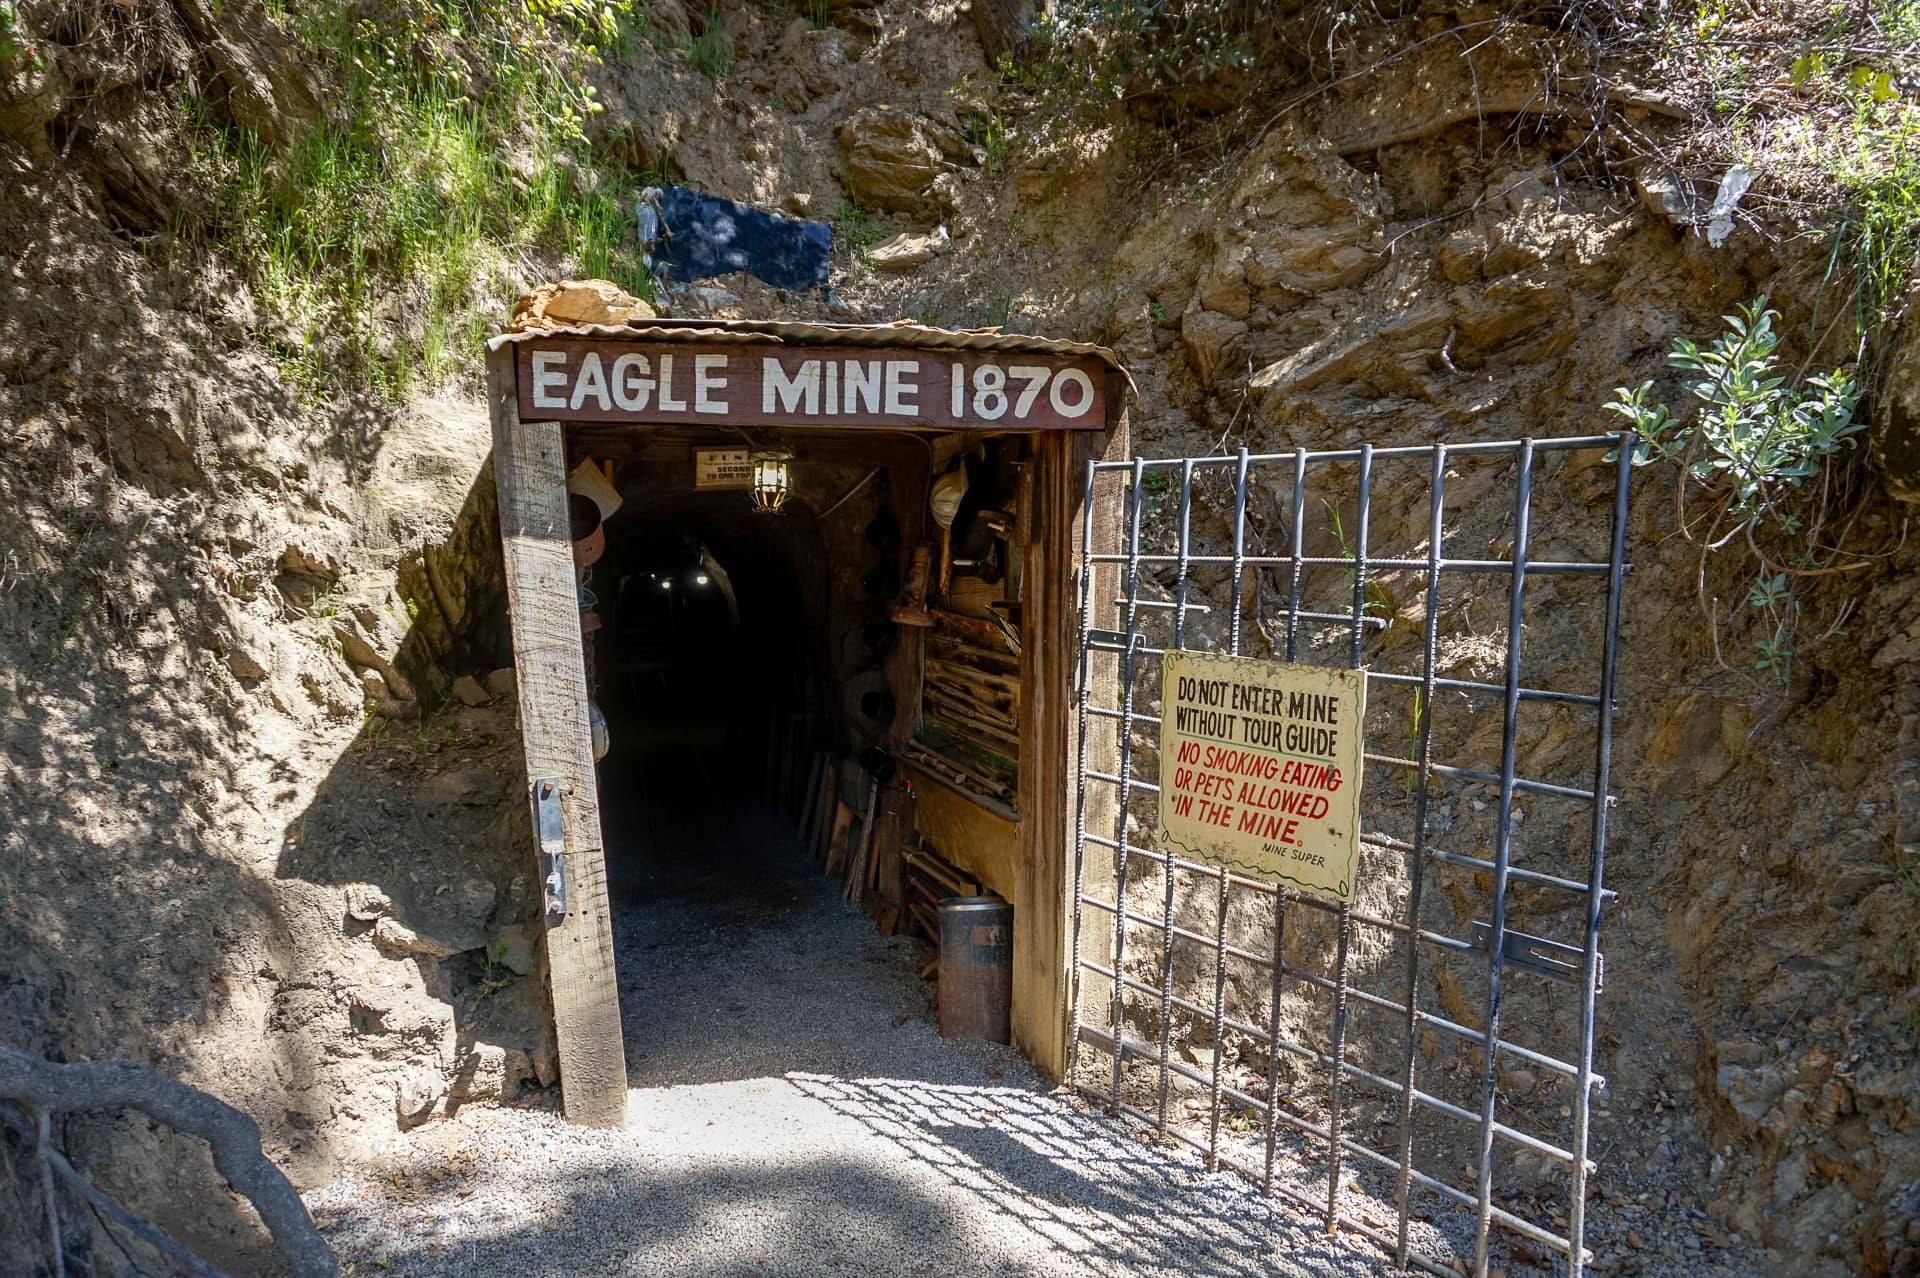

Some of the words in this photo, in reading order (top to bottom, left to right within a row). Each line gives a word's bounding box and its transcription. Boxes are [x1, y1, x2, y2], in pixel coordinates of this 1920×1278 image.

[532, 351, 729, 414] EAGLE
[762, 357, 920, 417] MINE
[951, 363, 1095, 421] 1870
[1178, 676, 1195, 701] DO
[1200, 679, 1229, 708] NOT
[1232, 684, 1283, 716] ENTER
[1288, 691, 1339, 725] MINE
[1176, 705, 1237, 740] WITHOUT
[1242, 716, 1282, 751] TOUR
[1286, 724, 1338, 757] GUIDE
[1177, 740, 1200, 765] NO
[1203, 745, 1279, 780] SMOKING
[1280, 760, 1343, 792] EATING
[1174, 767, 1192, 789] OR
[1194, 771, 1234, 801] PETS
[1237, 782, 1329, 820] ALLOWED
[1174, 794, 1193, 817] IN
[1199, 799, 1234, 828] THE
[1237, 811, 1304, 848] MINE.
[1262, 842, 1286, 857] MINE
[1291, 850, 1326, 868] SUPER
